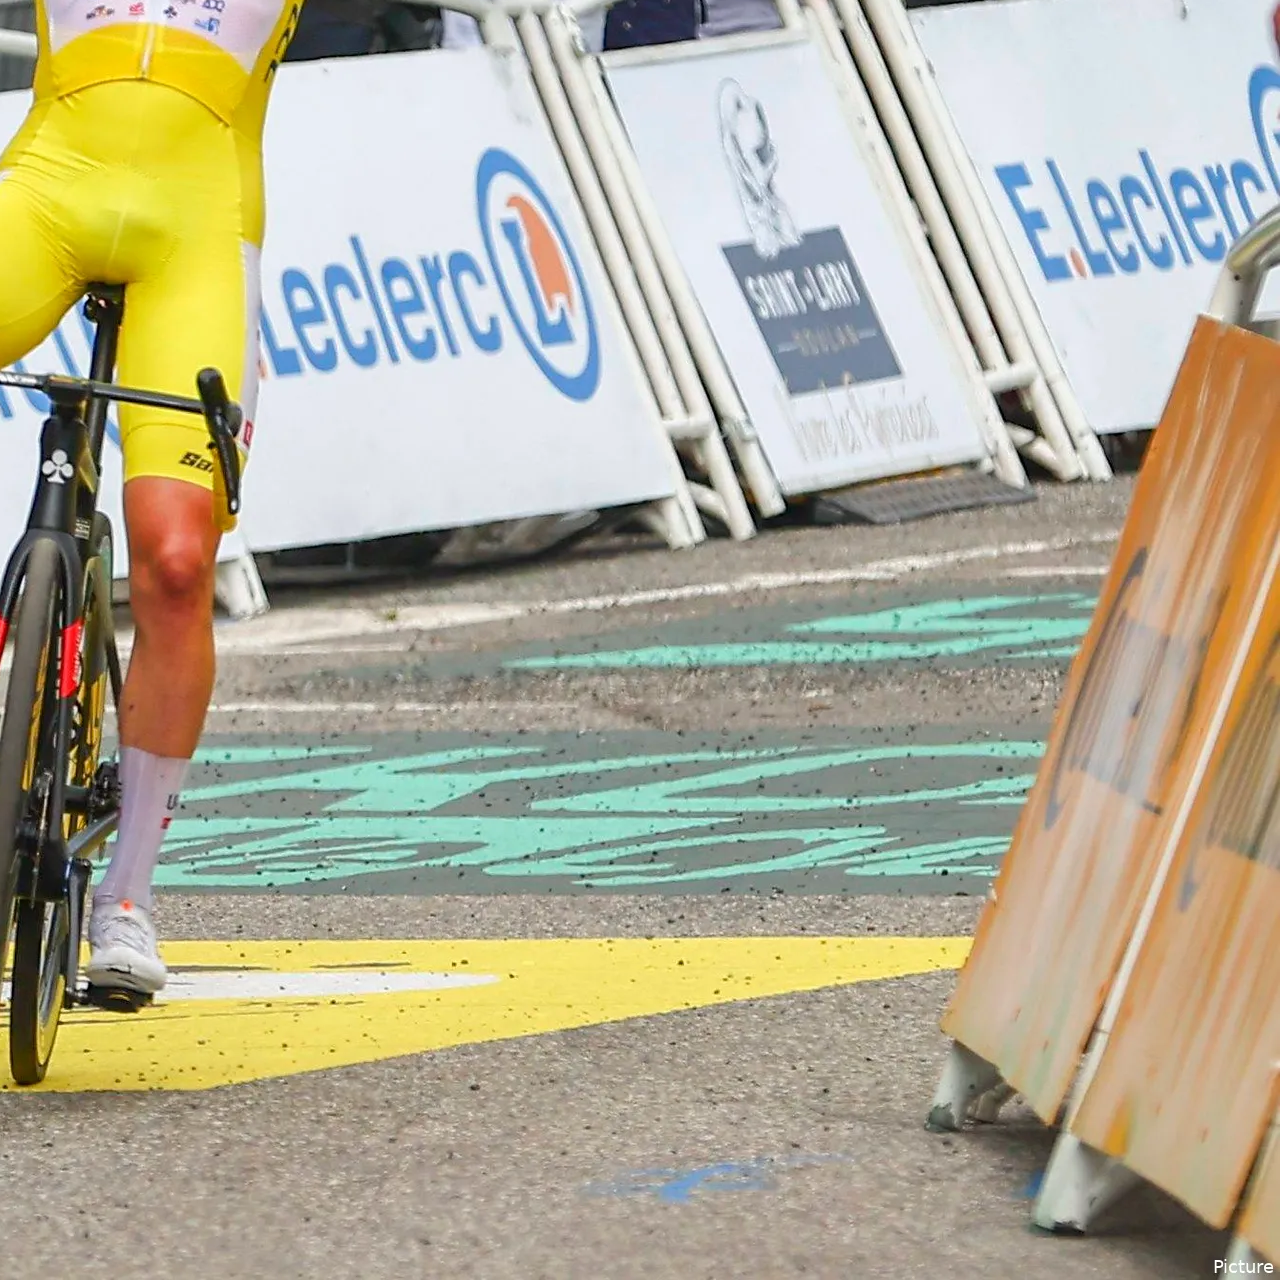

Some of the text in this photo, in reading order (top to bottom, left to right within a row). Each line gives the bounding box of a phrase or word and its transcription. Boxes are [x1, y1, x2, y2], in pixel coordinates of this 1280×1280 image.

[993, 146, 1267, 285] E.Leclerc
[260, 233, 503, 378] Leclerc
[744, 261, 862, 320] SAINT-LARY
